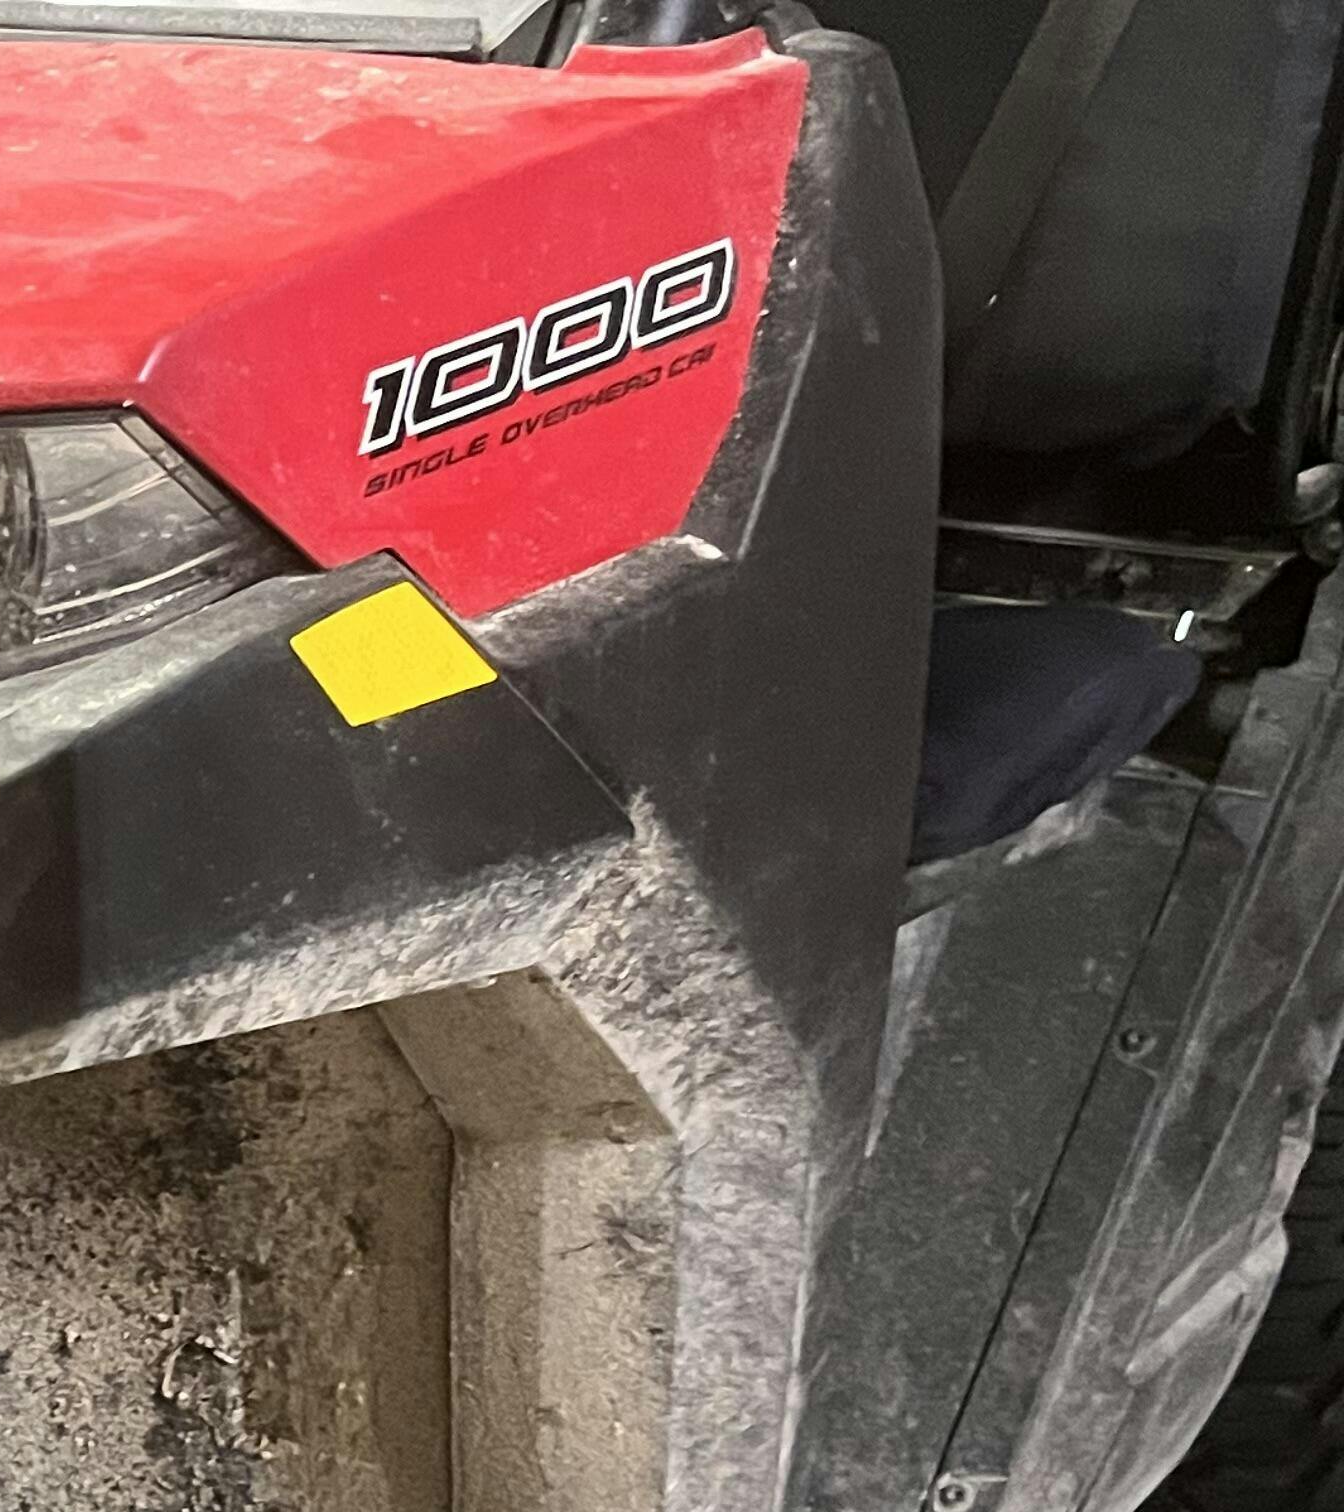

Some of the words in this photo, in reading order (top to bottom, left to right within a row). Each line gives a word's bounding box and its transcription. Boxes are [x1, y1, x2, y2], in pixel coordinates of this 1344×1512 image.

[357, 236, 736, 460] 1000
[363, 432, 490, 498] SINGLE
[500, 365, 663, 446] OVERHEAD
